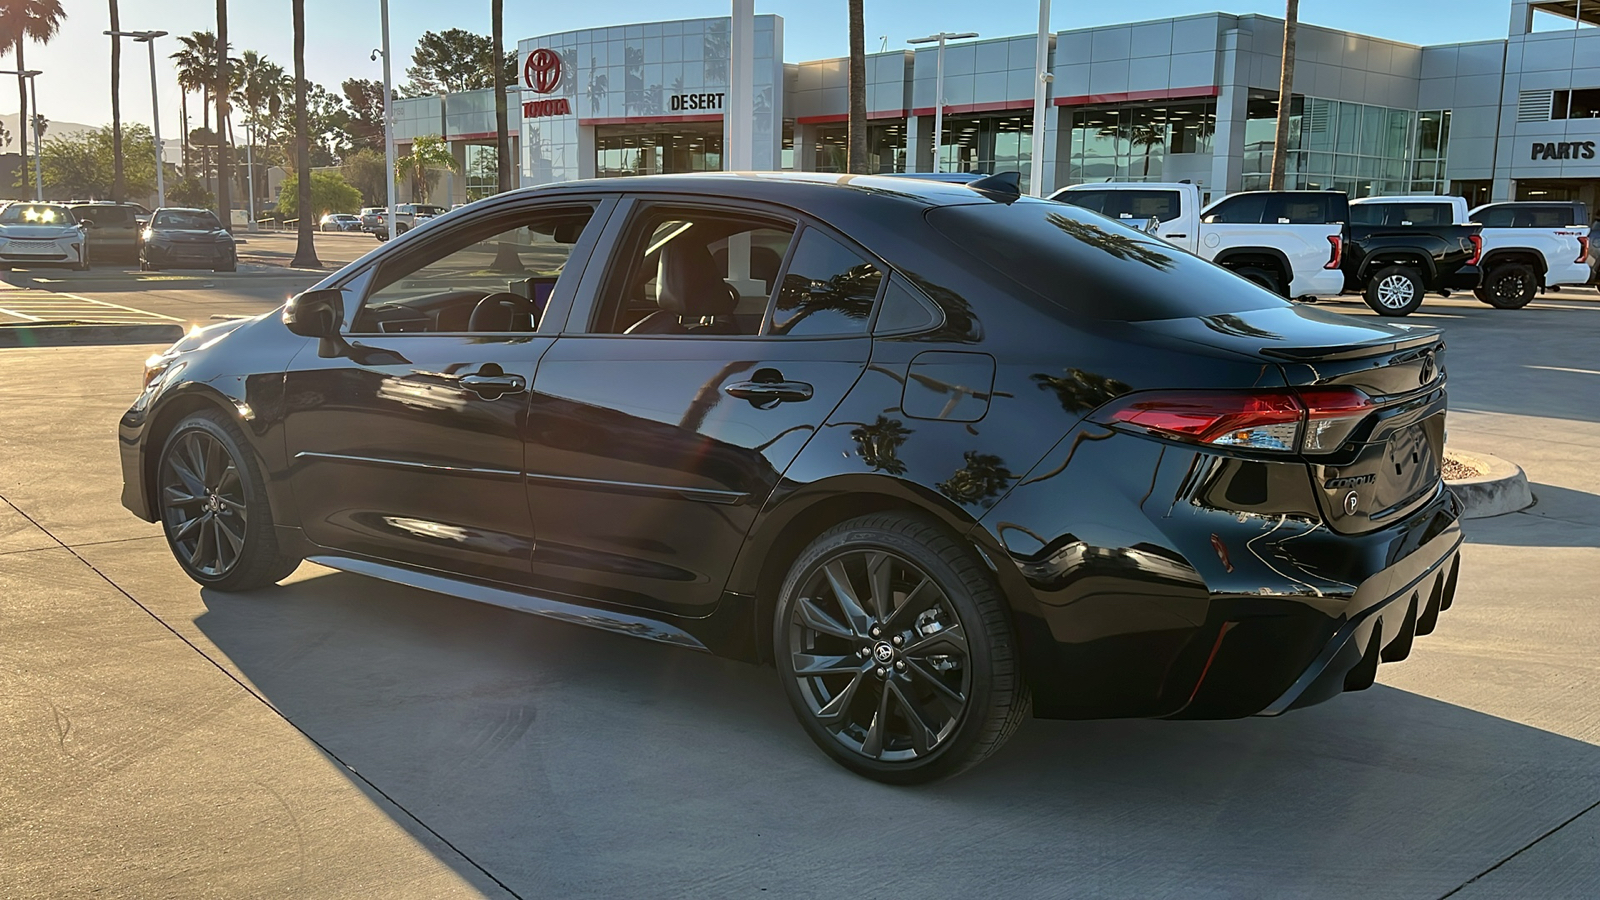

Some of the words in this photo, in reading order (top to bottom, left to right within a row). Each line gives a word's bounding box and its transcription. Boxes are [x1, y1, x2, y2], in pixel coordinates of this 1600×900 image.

[522, 98, 572, 118] TOYOTA
[671, 93, 725, 111] DESERT
[1531, 141, 1596, 160] PARTS
[1350, 497, 1357, 510] P
